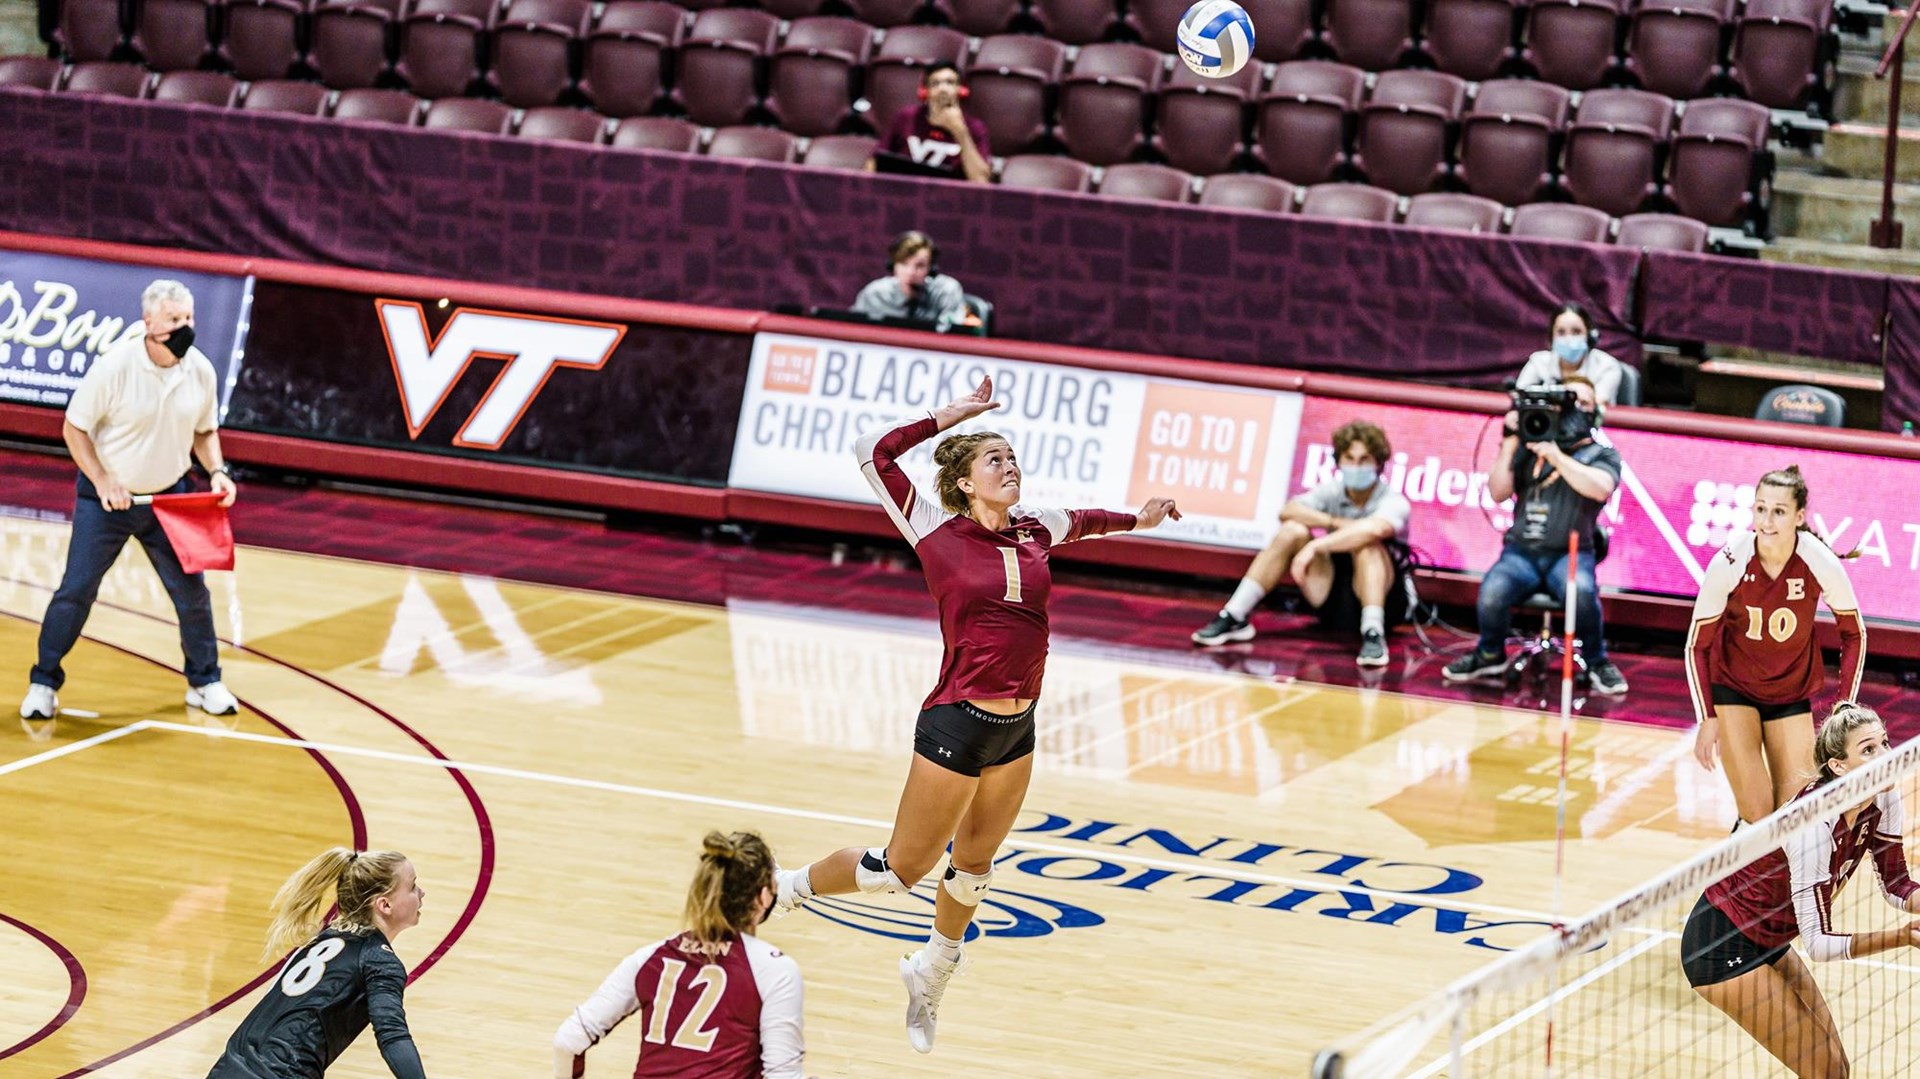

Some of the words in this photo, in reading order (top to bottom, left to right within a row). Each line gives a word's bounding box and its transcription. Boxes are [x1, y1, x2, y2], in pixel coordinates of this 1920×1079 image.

[907, 135, 961, 167] VT
[374, 298, 629, 450] VT
[1151, 410, 1192, 448] GO
[1201, 414, 1235, 453] TO
[996, 546, 1023, 603] 1
[1786, 578, 1806, 601] E
[1745, 605, 1798, 643] 10
[281, 937, 346, 997] 8
[644, 957, 727, 1052] 12
